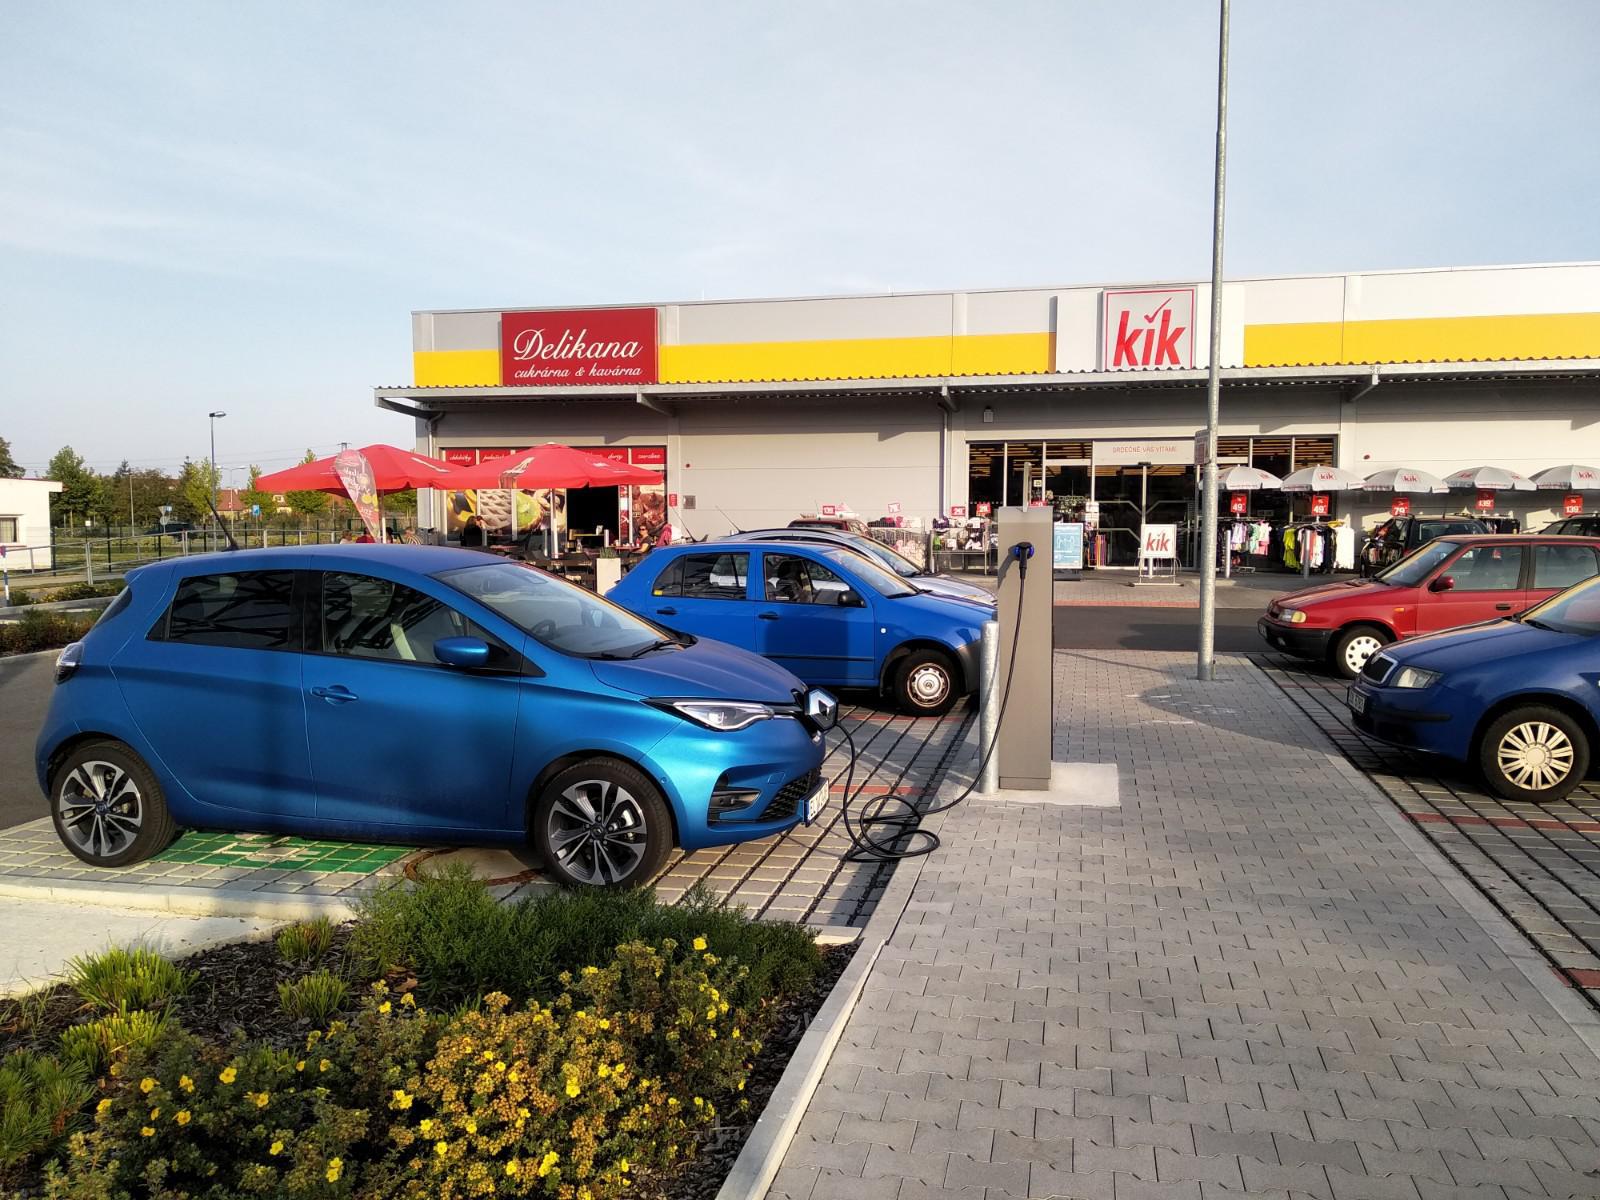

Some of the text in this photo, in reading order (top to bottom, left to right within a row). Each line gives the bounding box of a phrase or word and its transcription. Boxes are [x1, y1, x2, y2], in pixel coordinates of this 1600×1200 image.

[513, 328, 643, 360] Delikana
[1113, 298, 1186, 366] kik
[514, 362, 642, 378] cukrárna & kavárna
[1145, 531, 1169, 552] kik
